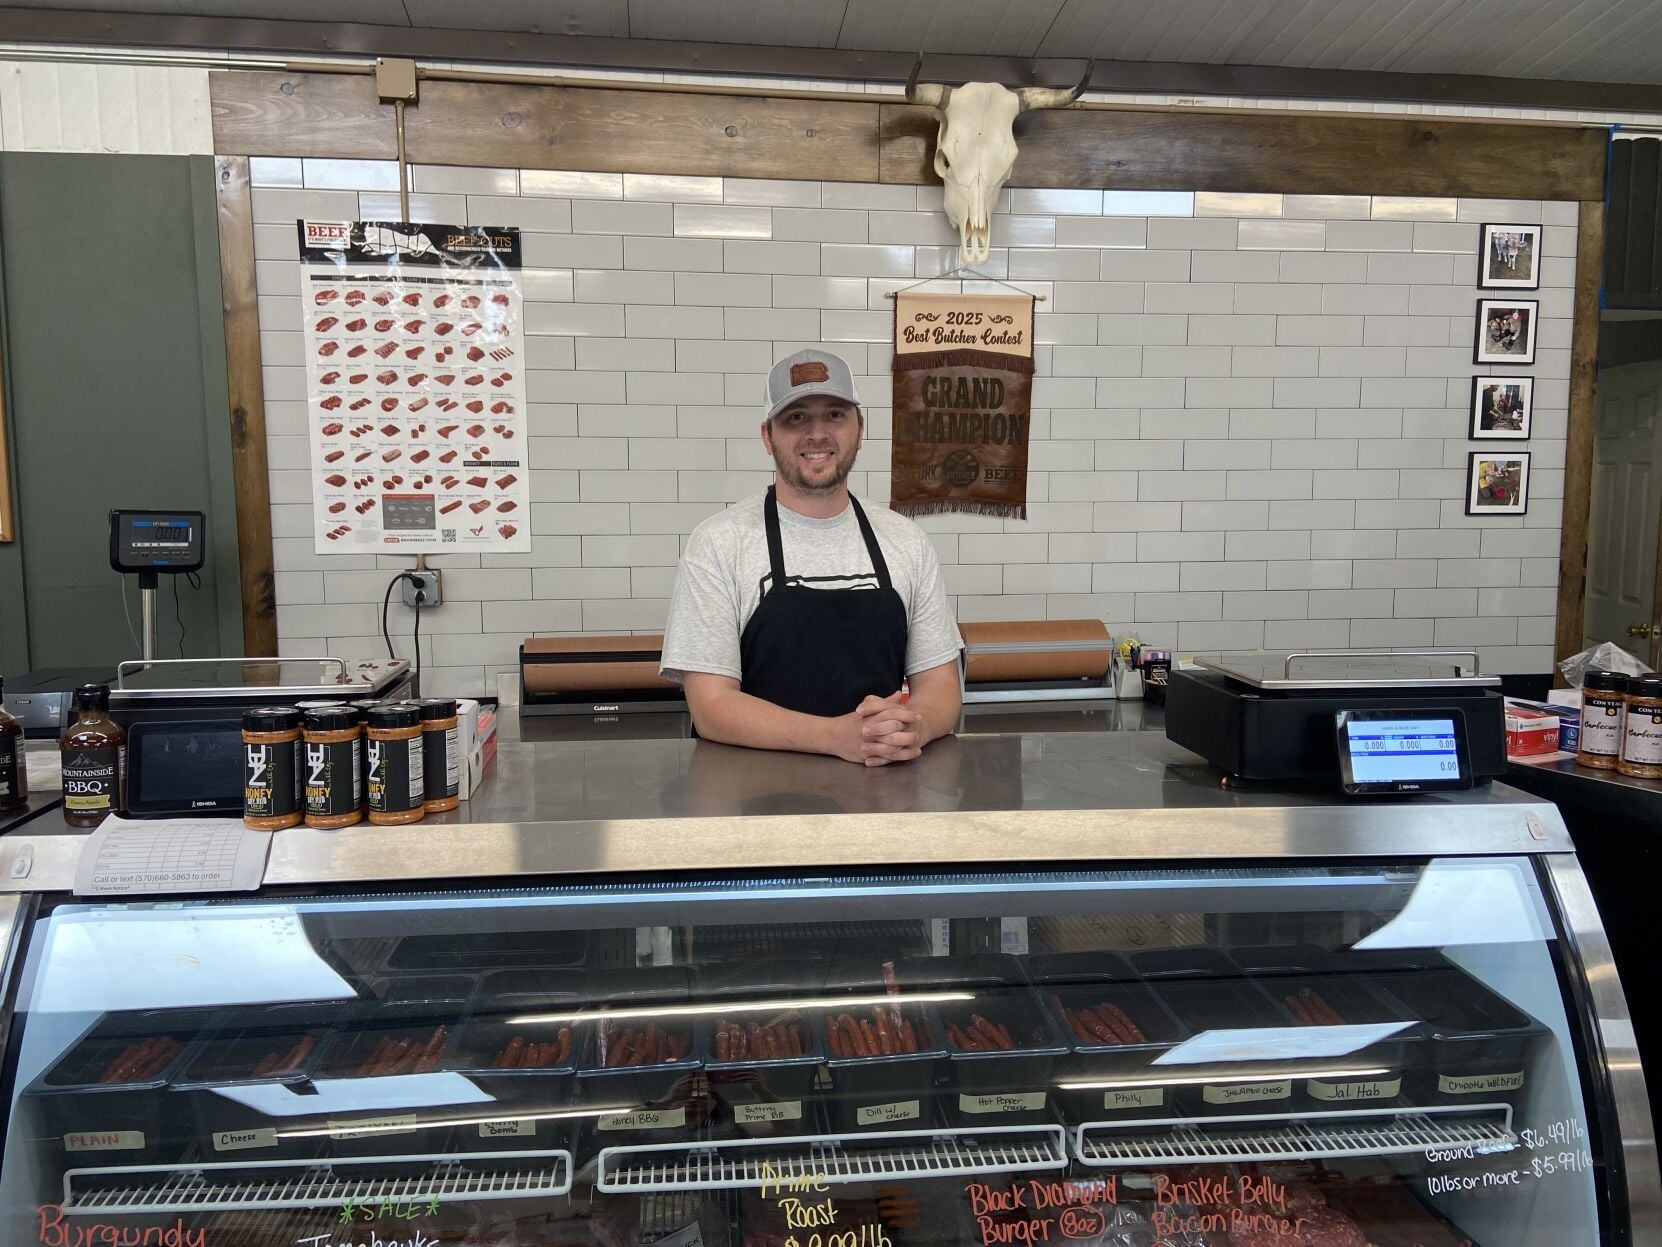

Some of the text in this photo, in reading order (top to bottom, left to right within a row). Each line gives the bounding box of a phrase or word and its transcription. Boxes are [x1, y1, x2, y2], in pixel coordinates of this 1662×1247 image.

[307, 225, 347, 238] BEEF
[945, 312, 983, 325] 2025
[903, 326, 1023, 346] Best Butcher Contest
[922, 376, 1004, 409] GRAND
[897, 411, 1025, 445] CHAMPION
[1584, 721, 1617, 730] Barbecue
[1543, 731, 1559, 743] vinyl
[1628, 729, 1662, 739] Barbecue
[1365, 740, 1455, 750] 0.000 0.000 0.00
[63, 766, 114, 778] MOUNTAINSIDE
[1440, 761, 1457, 771] 0.00
[68, 780, 103, 794] BBQ
[245, 788, 273, 799] HONEY
[305, 787, 331, 798] HONEY
[94, 874, 109, 883] Call
[119, 875, 133, 883] text
[135, 873, 191, 883] (570)660-5863
[200, 872, 221, 880] order
[1356, 1083, 1380, 1097] Hab
[1448, 1080, 1484, 1091] Chipotle
[978, 1098, 992, 1106] Hot
[1114, 1093, 1142, 1105] Philly
[866, 1108, 882, 1117] Dill
[612, 1114, 660, 1126] Honey BBQ
[490, 1126, 518, 1135] Bomb
[69, 1134, 120, 1147] PLAIN
[221, 1133, 256, 1145] Cheese
[1425, 1145, 1475, 1163] Ground
[1521, 1118, 1584, 1150] $6.49/lb
[1463, 1176, 1480, 1189] or
[1483, 1171, 1520, 1187] more
[1531, 1149, 1593, 1179] $5.99/lb
[762, 1161, 830, 1198] Prime
[965, 1174, 1117, 1216] Black Diamond
[1152, 1174, 1286, 1214] Brisket Belly
[778, 1197, 838, 1230] Roast
[37, 1204, 206, 1247] Burgundy
[977, 1211, 1097, 1247] Burger 8oz
[1152, 1208, 1315, 1245] Bacon Burger
